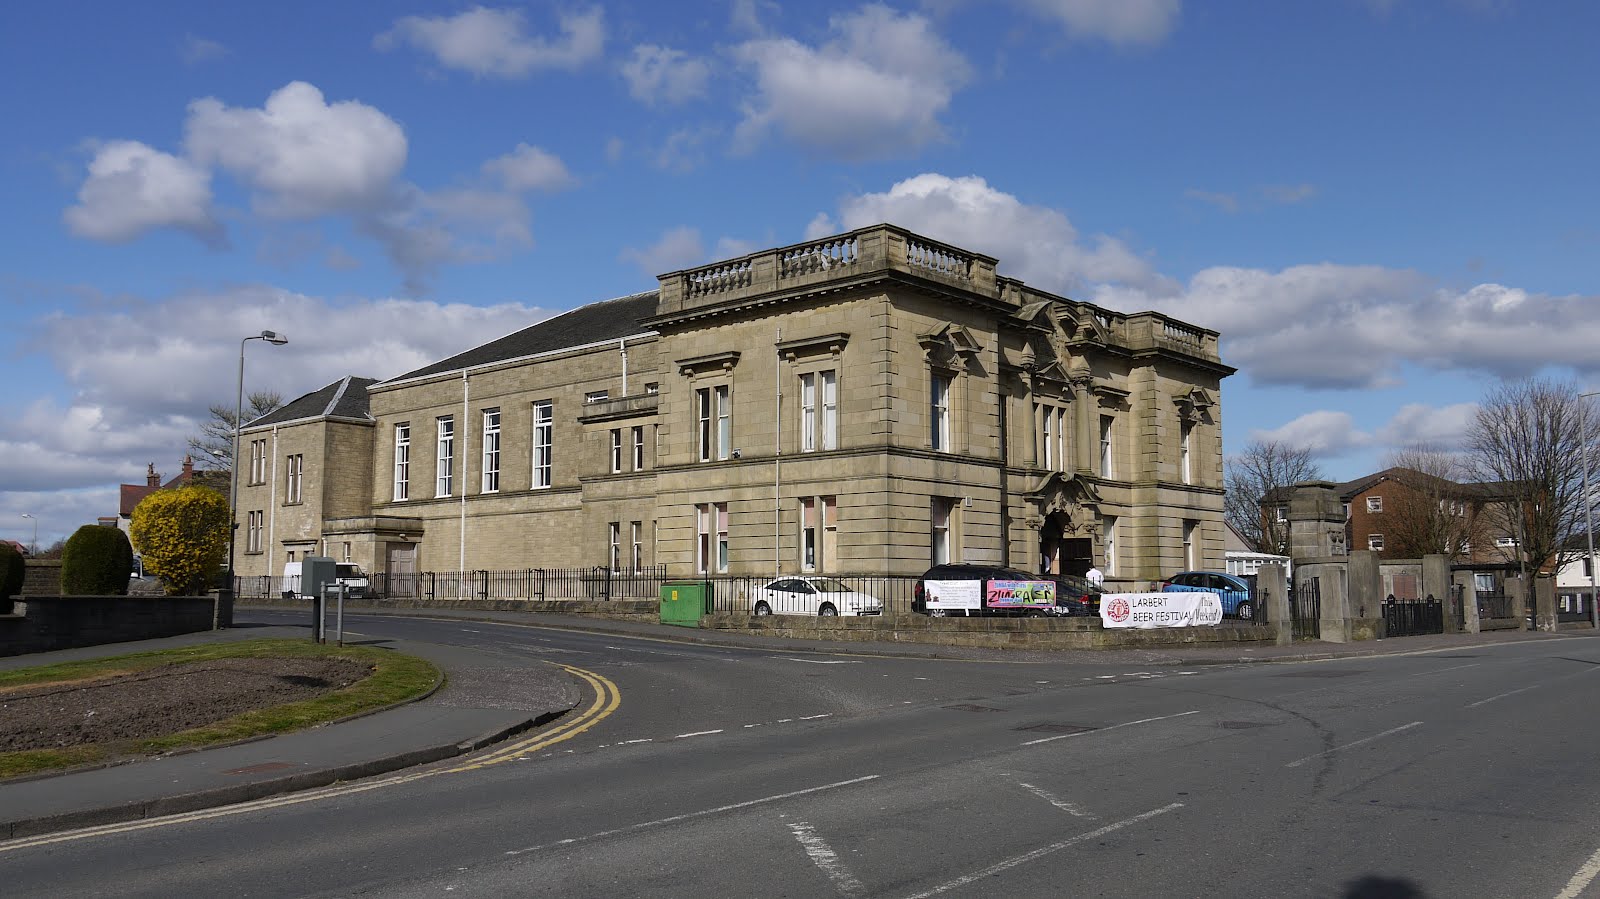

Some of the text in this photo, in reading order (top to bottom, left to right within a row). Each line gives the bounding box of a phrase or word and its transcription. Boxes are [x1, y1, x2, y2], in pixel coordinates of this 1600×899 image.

[1132, 597, 1168, 608] LARBERT
[1133, 611, 1193, 622] BEER FESTIVAL
